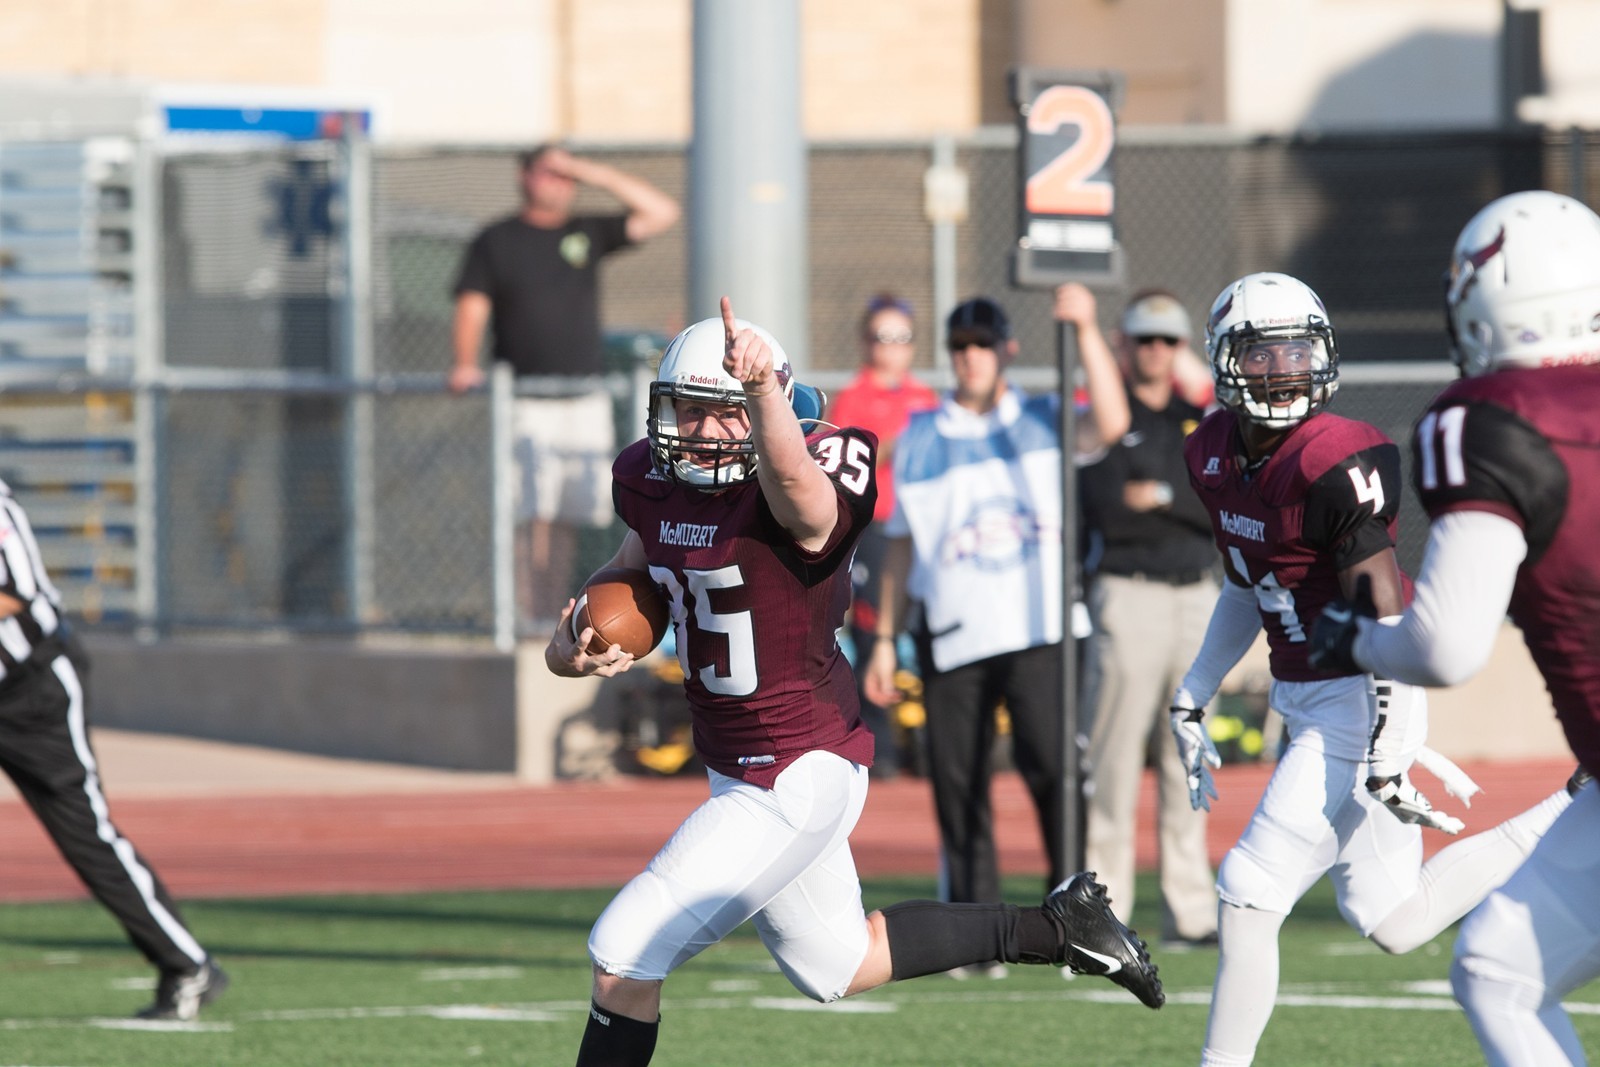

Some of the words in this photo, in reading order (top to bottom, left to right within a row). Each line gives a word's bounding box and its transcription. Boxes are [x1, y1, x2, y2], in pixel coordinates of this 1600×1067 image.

[1026, 84, 1114, 216] 2
[689, 374, 719, 386] Riddell
[815, 436, 870, 497] 35
[1418, 405, 1469, 490] 11
[1347, 466, 1386, 515] 4
[658, 520, 719, 548] McMURRY
[1219, 509, 1266, 543] McMURRY
